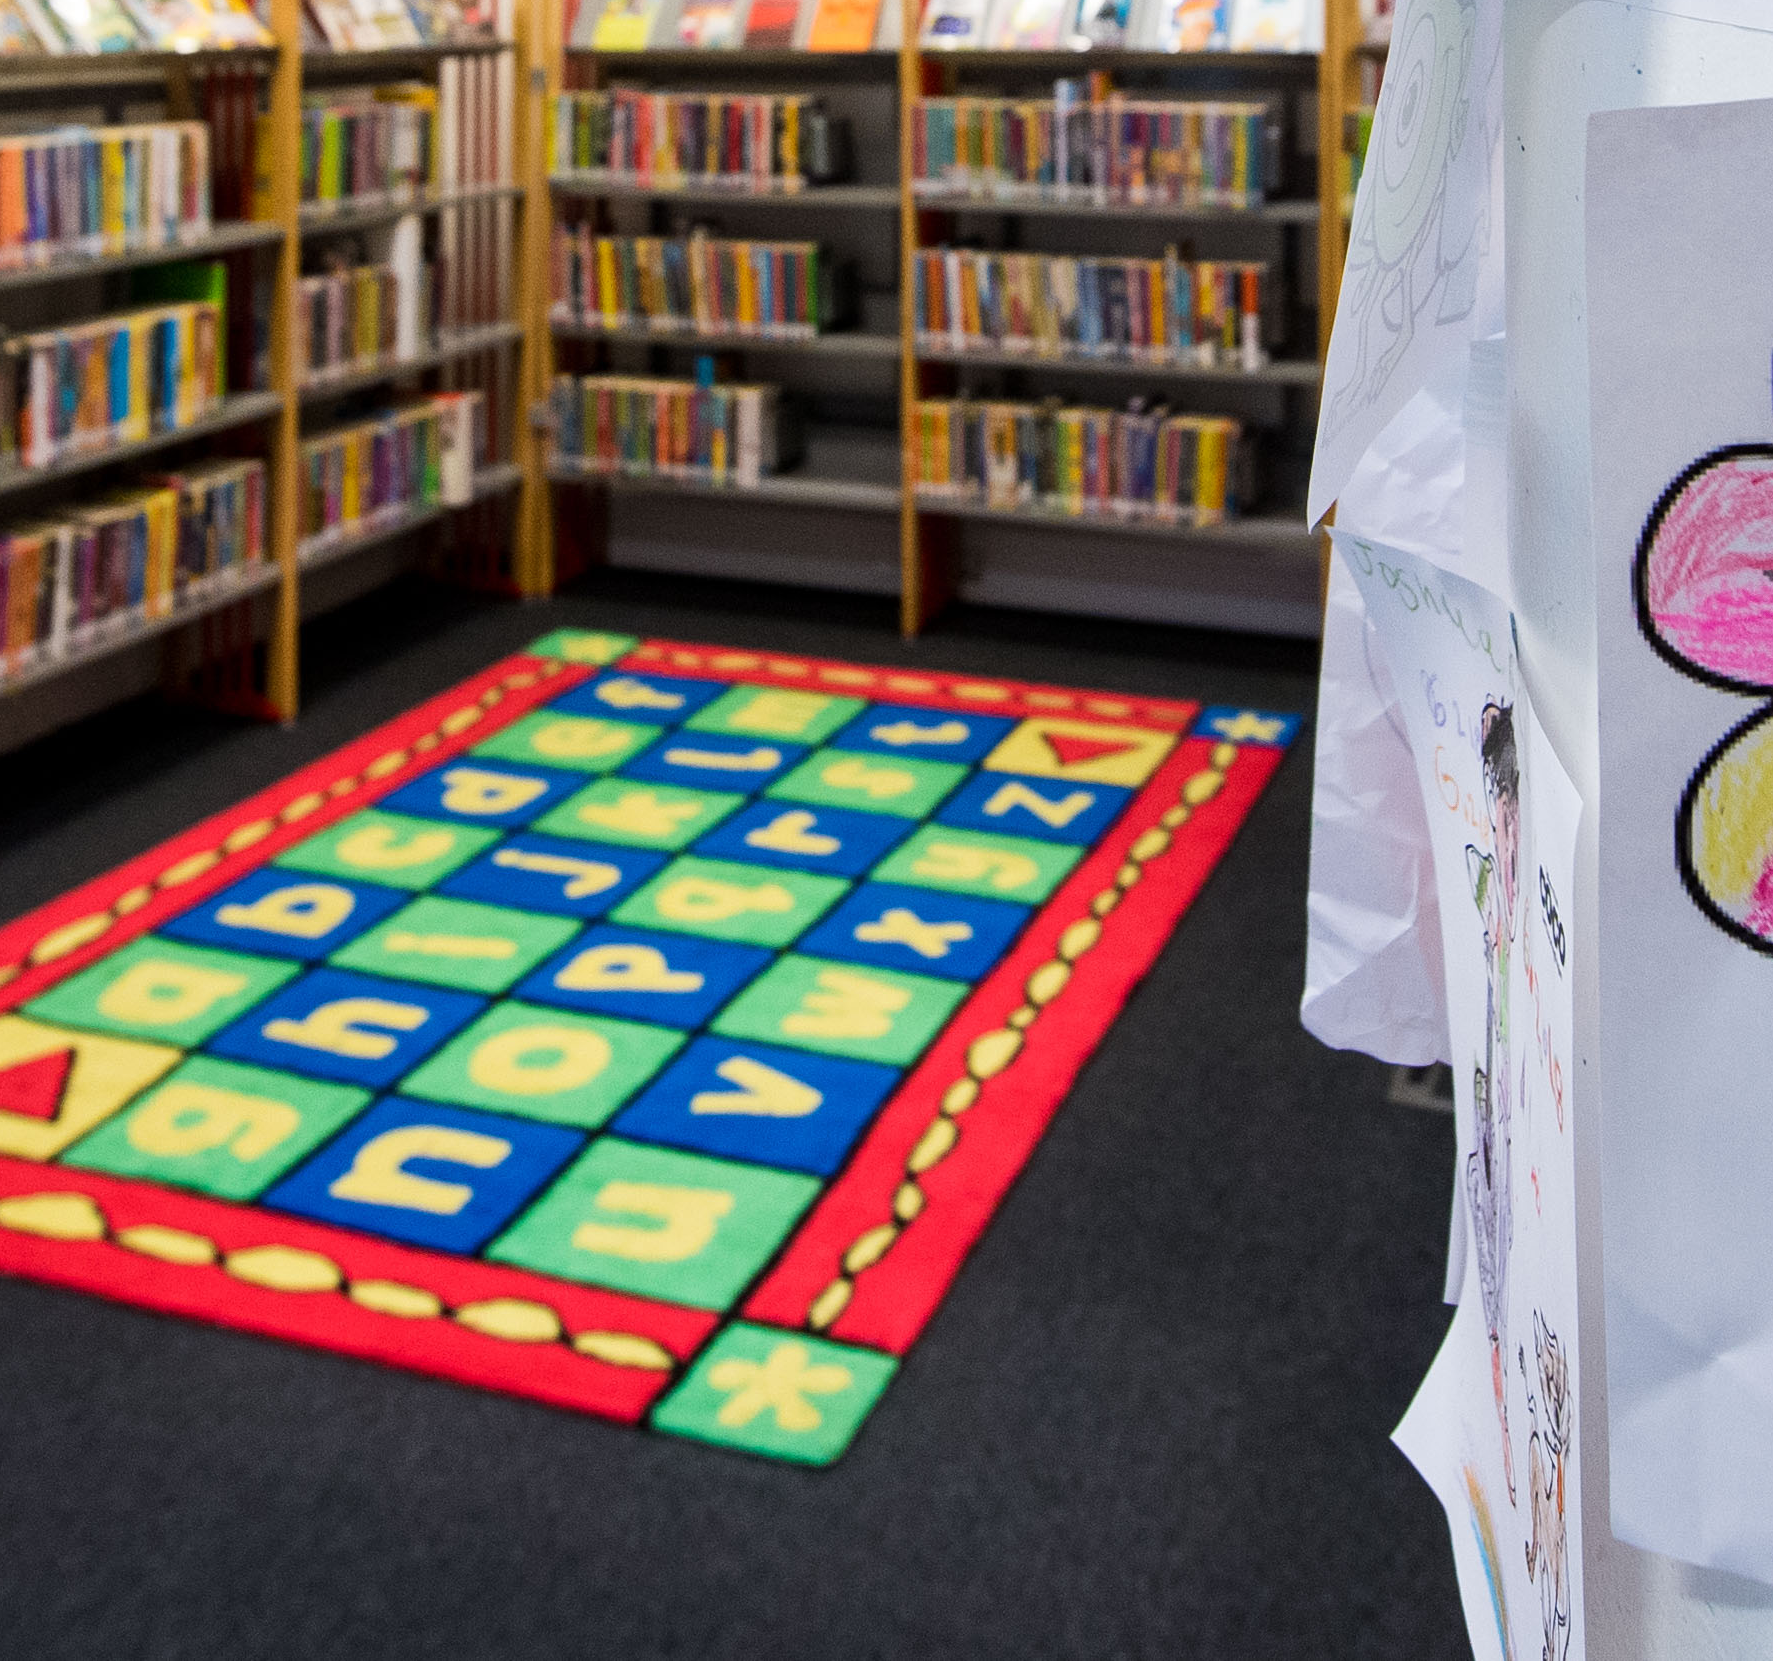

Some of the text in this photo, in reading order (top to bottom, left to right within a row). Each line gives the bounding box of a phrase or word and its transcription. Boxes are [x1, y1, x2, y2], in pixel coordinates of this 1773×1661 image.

[97, 960, 249, 1024] a
[215, 883, 354, 938] b
[336, 825, 455, 868] c
[442, 768, 548, 814] d
[127, 1081, 300, 1163] g
[263, 999, 428, 1059] h
[384, 932, 518, 958] i
[492, 848, 621, 899] j
[577, 791, 703, 836] k
[664, 748, 782, 770] l
[329, 721, 969, 1215] n o p q r s t
[572, 782, 1095, 1263] u v w x y z
